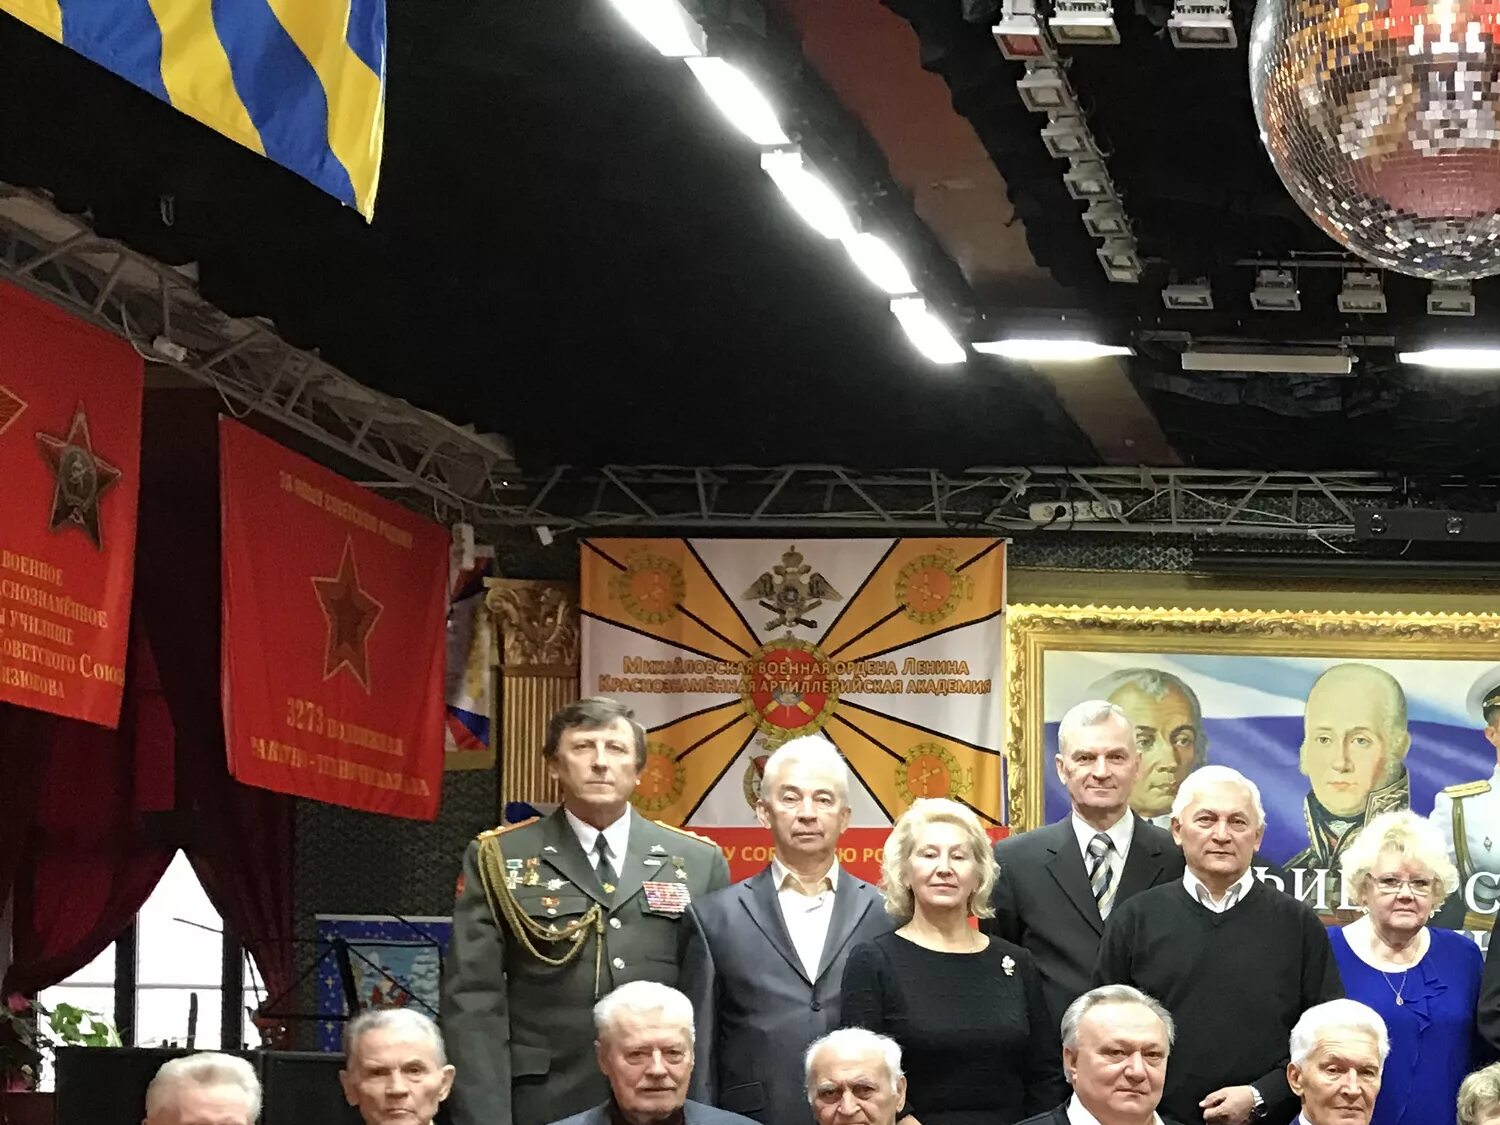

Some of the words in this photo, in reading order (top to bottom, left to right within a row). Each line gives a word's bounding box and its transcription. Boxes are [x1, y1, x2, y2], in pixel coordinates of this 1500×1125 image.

[2, 550, 63, 586] ВОЕННОЕ
[0, 579, 108, 628] СНОЗНАМЁННОЕ
[0, 630, 76, 673] ОВЕТСКОГО
[759, 660, 830, 675] ВОЕННАЯ
[835, 660, 897, 676] ОРДЕНА
[902, 657, 969, 675] ЛЕНИНА
[0, 665, 65, 698] ИЗЮКОВА
[760, 676, 903, 693] АРТИЛЛЕРИЙСКАЯ
[906, 678, 992, 696] АКАДЕМИЯ
[286, 697, 324, 735] 3273
